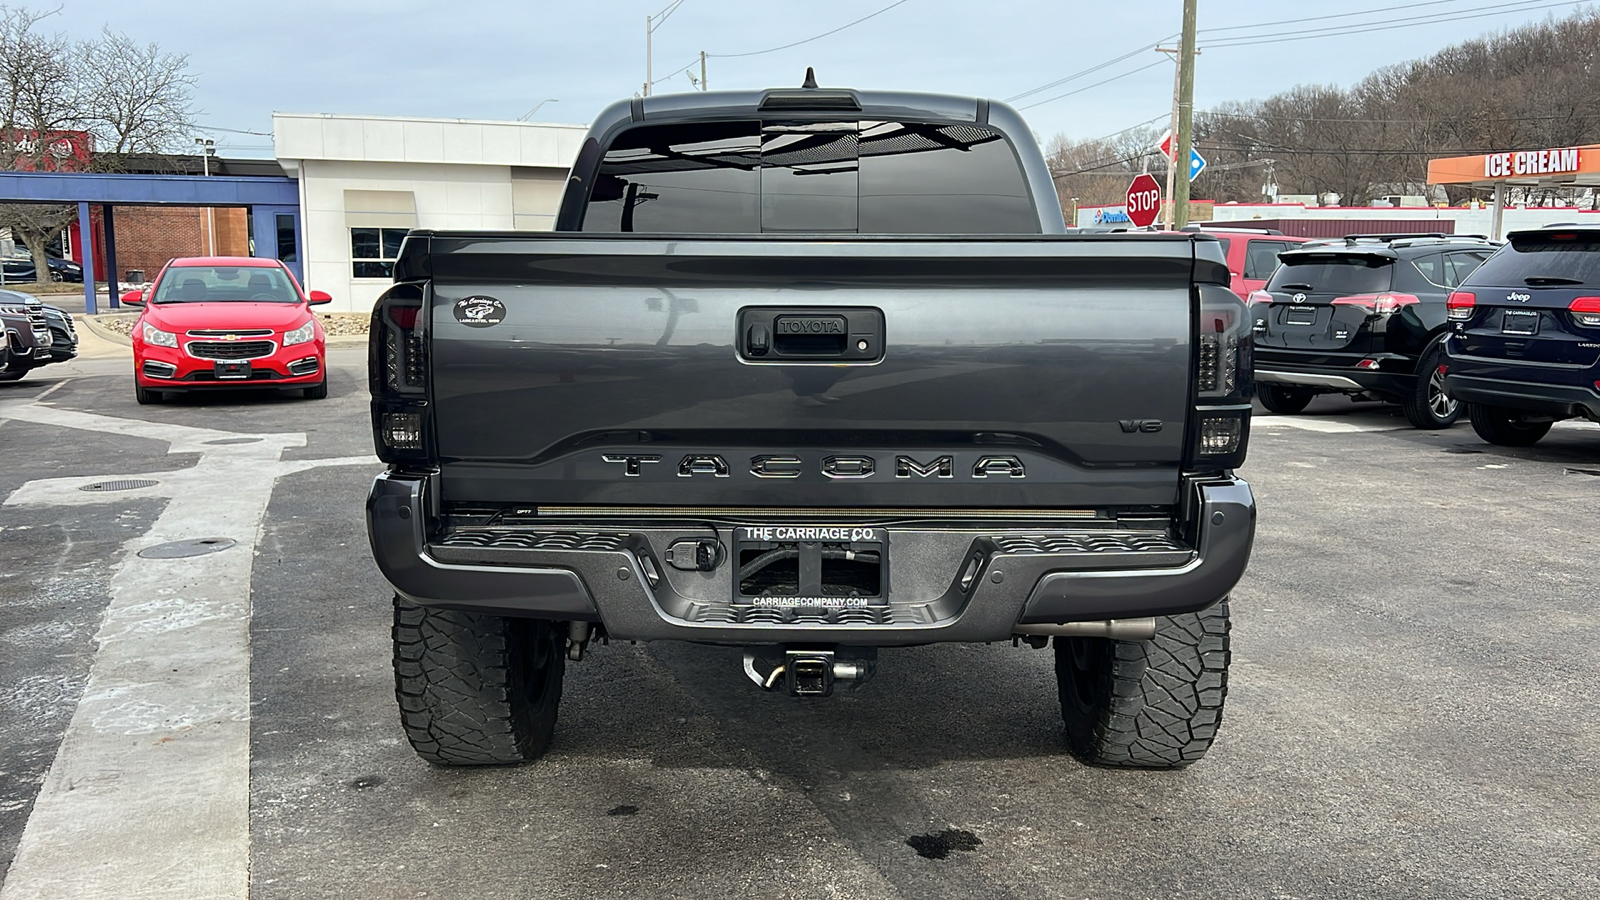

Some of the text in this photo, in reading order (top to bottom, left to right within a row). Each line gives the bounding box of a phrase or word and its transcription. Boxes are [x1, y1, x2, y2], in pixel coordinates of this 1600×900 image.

[1485, 149, 1579, 177] ICE CREAM
[1129, 190, 1158, 212] STOP
[1102, 210, 1130, 223] Domino
[1507, 292, 1530, 302] Jeep
[781, 320, 842, 333] TOYOTA
[1119, 419, 1163, 433] V6
[601, 454, 1026, 479] TACOMA
[744, 527, 877, 540] THE CARRIAGE CO.
[753, 598, 868, 607] CARRIAGECOMPANY.COM
